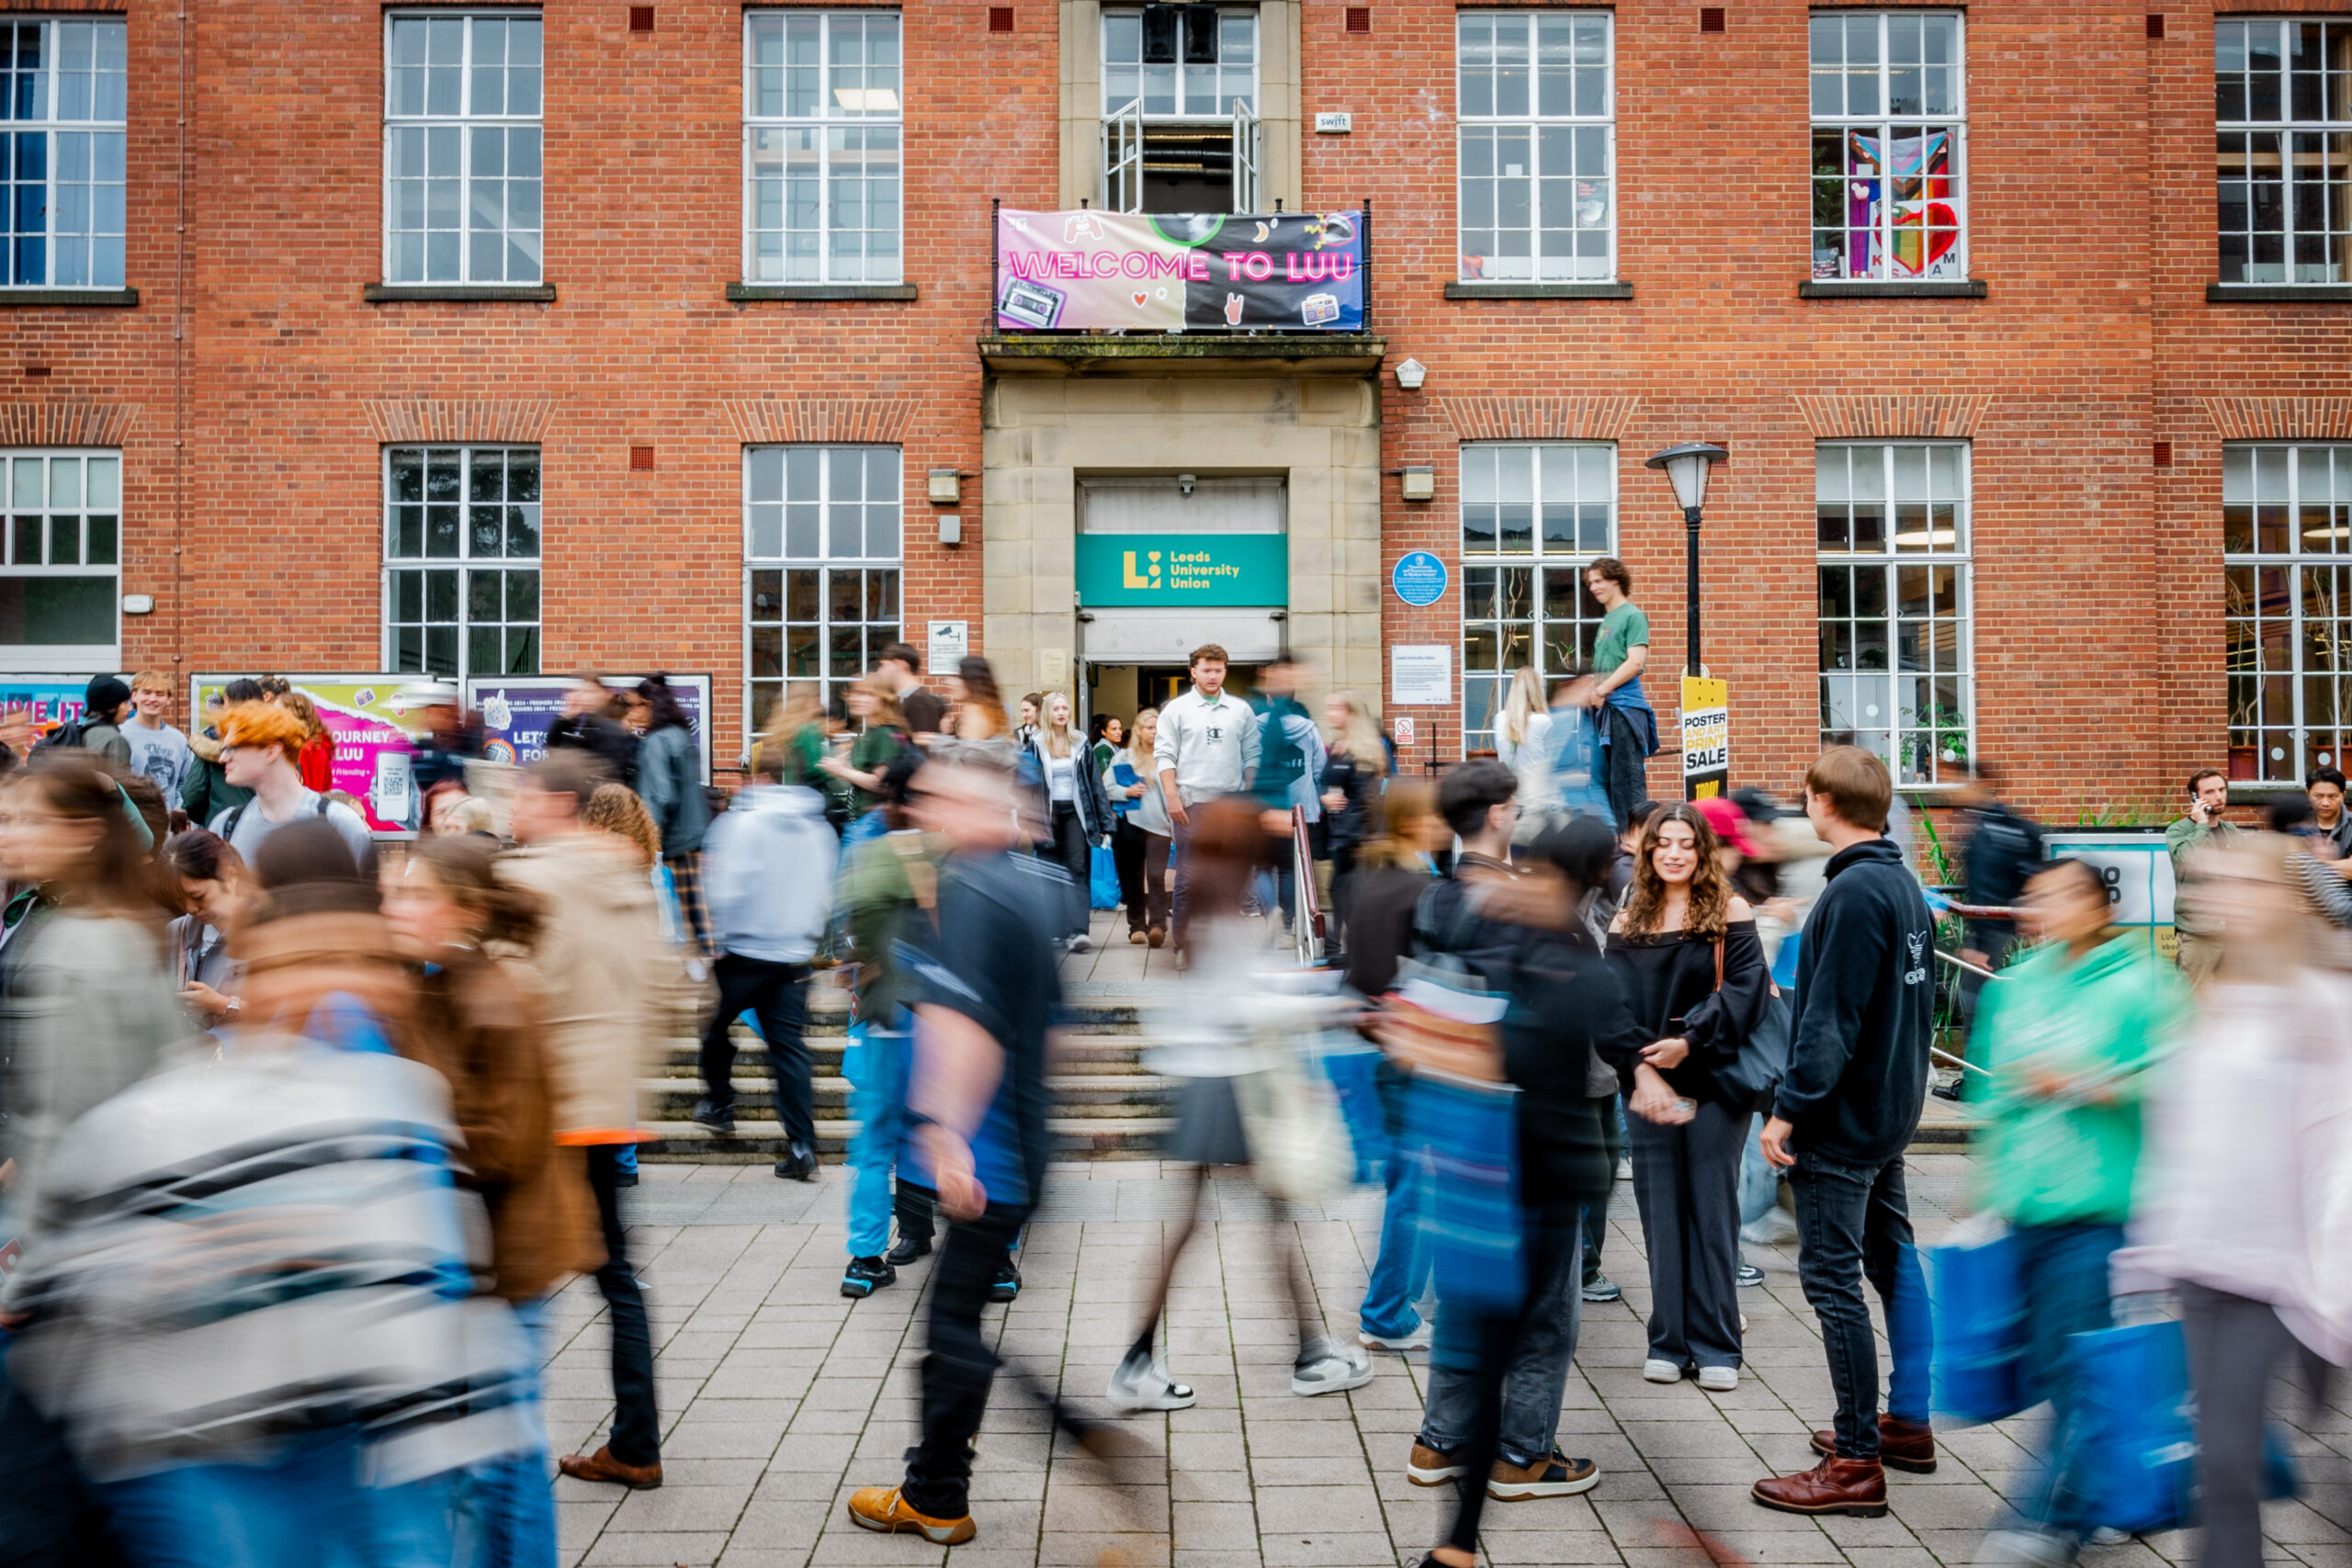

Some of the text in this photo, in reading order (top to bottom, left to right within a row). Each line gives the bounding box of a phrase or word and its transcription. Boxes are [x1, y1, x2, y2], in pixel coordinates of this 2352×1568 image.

[1321, 115, 1346, 128] swift
[1010, 251, 1353, 282] WELCOME TO LUU
[1170, 551, 1211, 562] Leeds
[1170, 564, 1240, 579] University
[1170, 578, 1210, 589] Union
[59, 701, 85, 725] IT
[1685, 713, 1725, 728] POSTER
[332, 730, 390, 743] OURNEY
[1685, 724, 1725, 739] AND ART
[1685, 734, 1726, 753] PRINT
[335, 748, 364, 761] LUU
[1686, 748, 1725, 770] SALE
